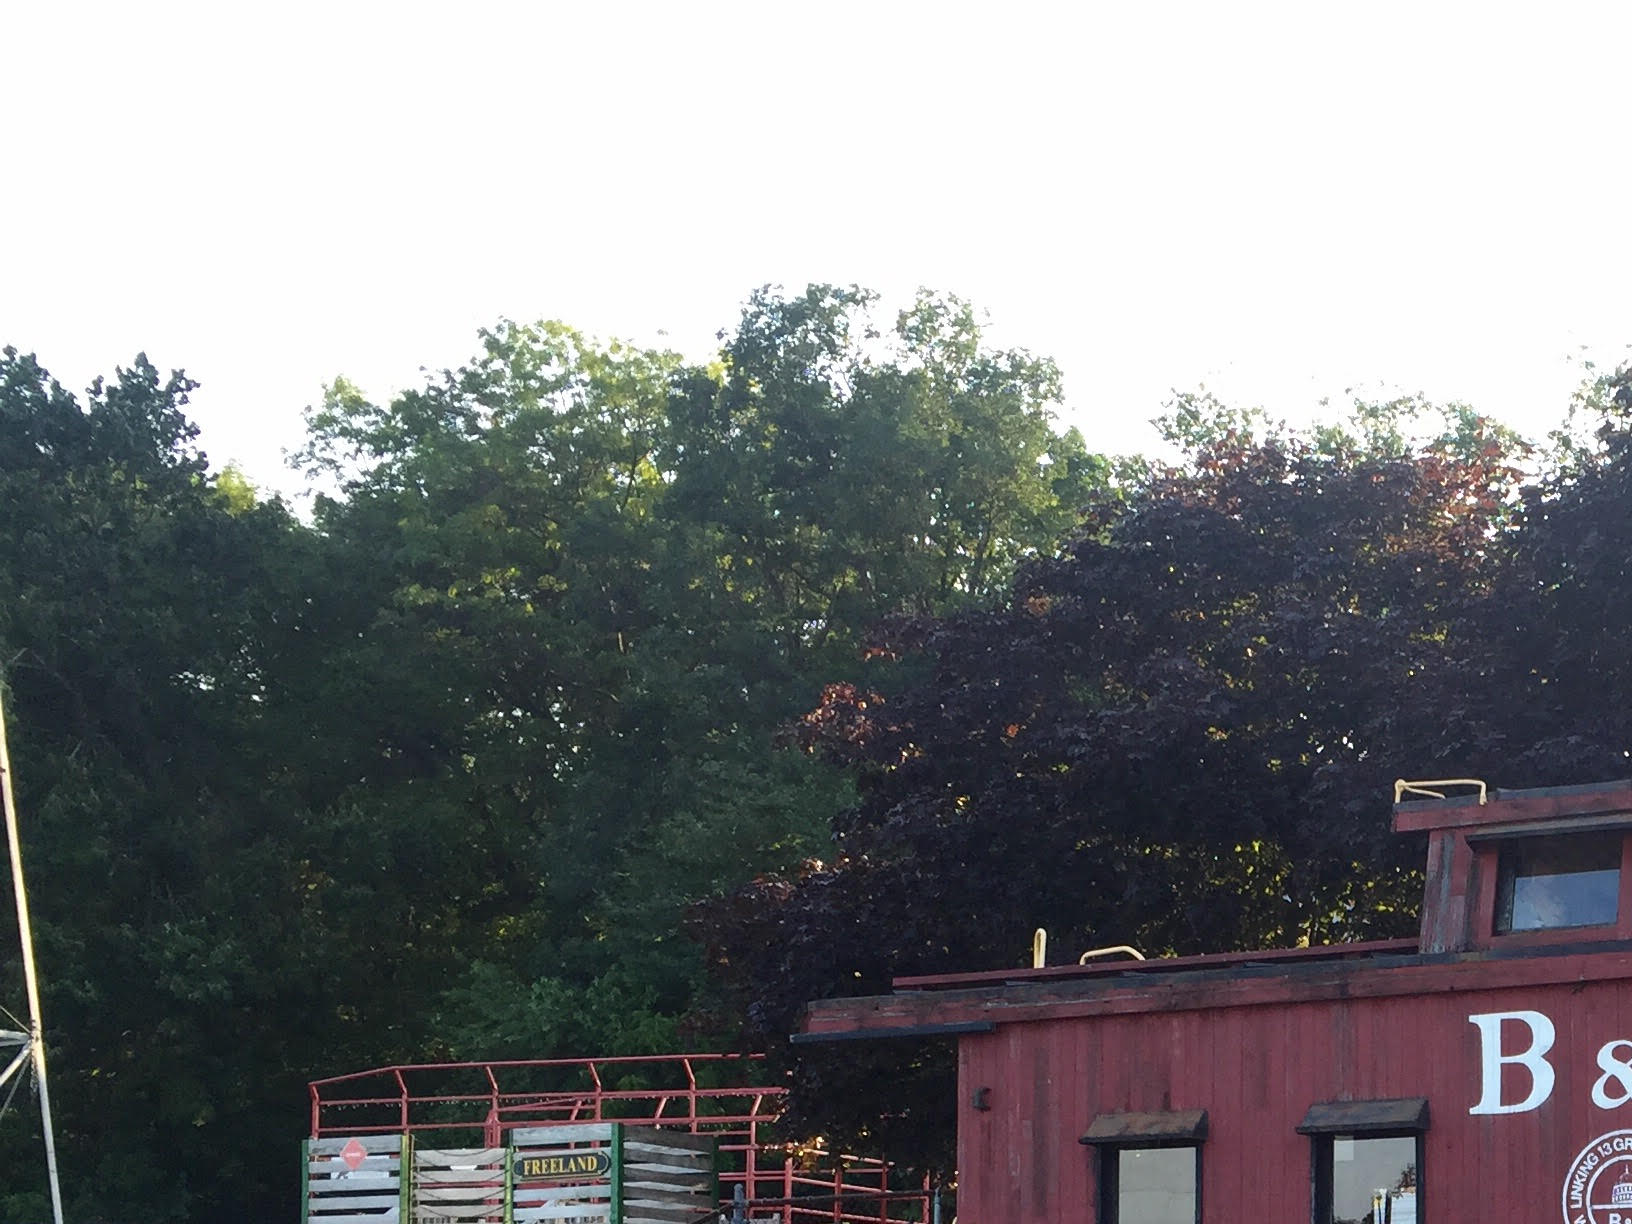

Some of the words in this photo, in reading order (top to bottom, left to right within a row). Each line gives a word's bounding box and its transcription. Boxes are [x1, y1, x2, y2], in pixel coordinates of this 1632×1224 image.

[1468, 1010, 1556, 1115] B
[523, 1155, 598, 1175] FREELAND
[1570, 1152, 1599, 1209] LINKING
[1597, 1142, 1613, 1158] 13
